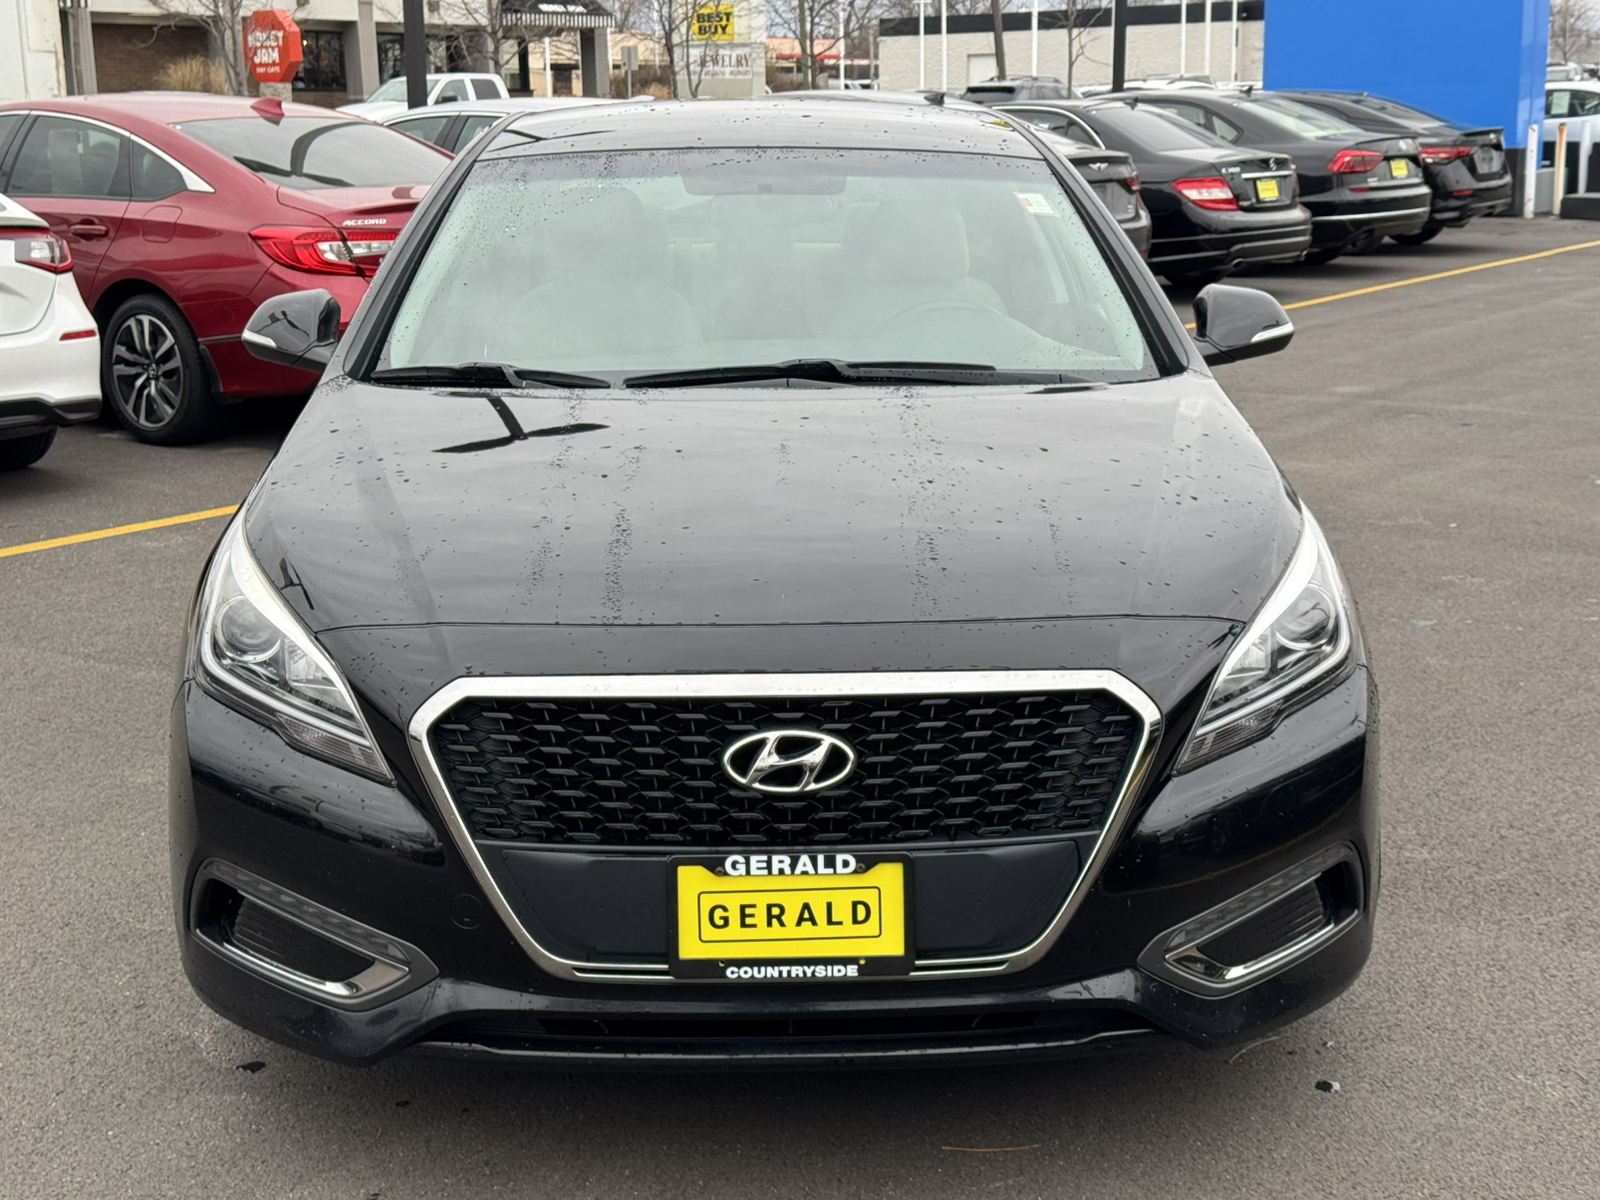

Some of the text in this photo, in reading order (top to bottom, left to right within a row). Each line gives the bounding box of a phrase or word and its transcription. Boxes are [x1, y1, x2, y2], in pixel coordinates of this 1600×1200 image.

[696, 12, 733, 23] BEST
[698, 24, 729, 36] BUY
[254, 47, 280, 64] JAM
[342, 218, 387, 226] ACCORD
[724, 853, 856, 876] GERALD
[708, 900, 872, 930] GERALD
[725, 964, 858, 979] COUNTRYSIDE
